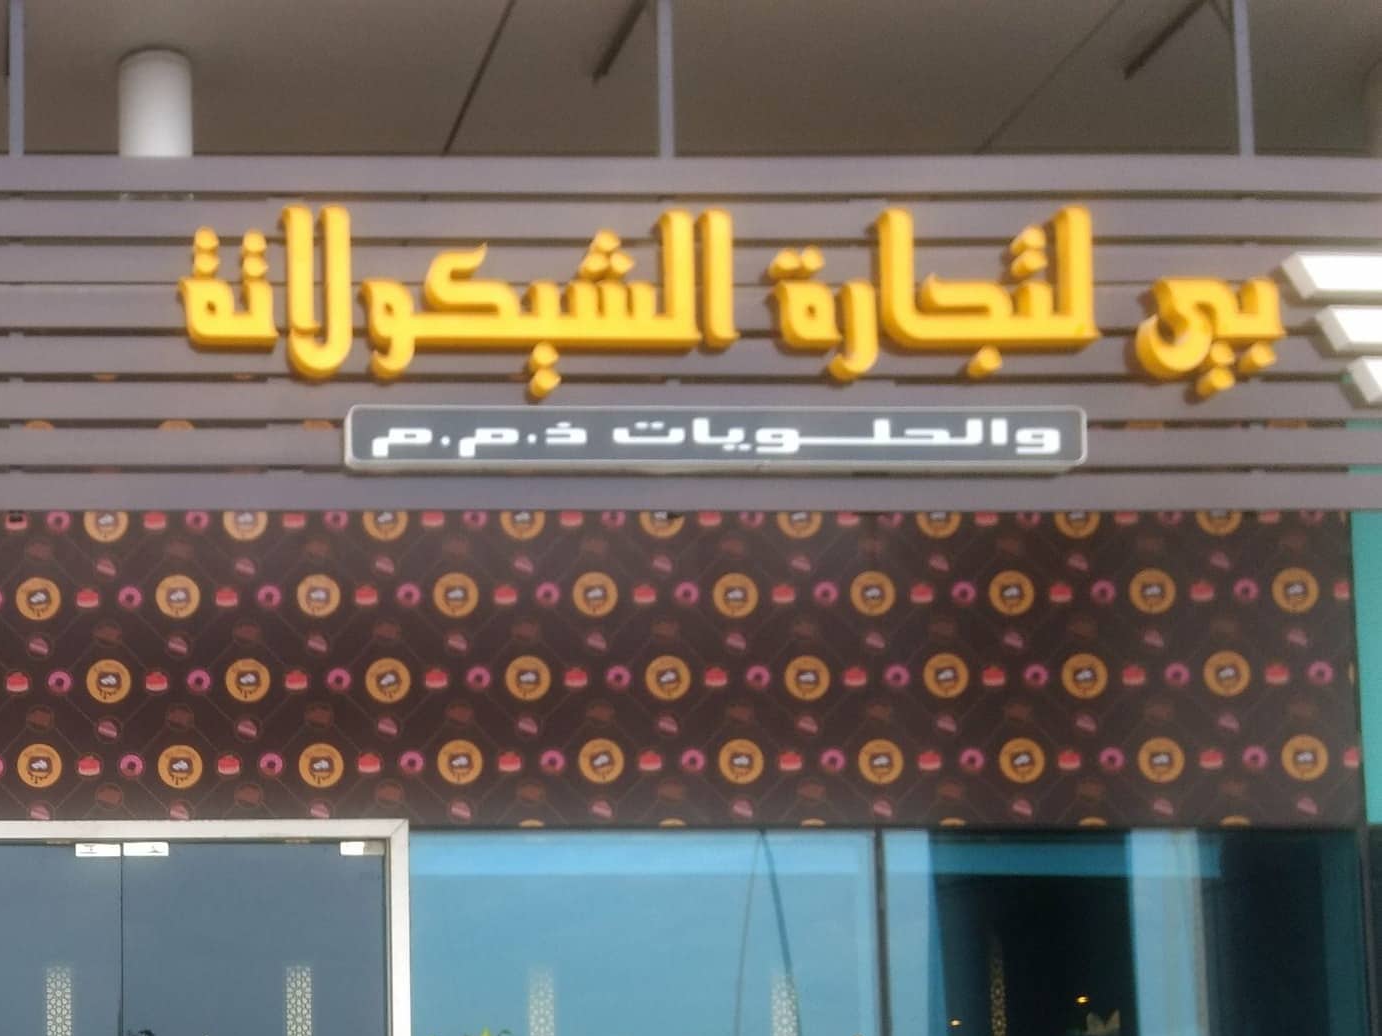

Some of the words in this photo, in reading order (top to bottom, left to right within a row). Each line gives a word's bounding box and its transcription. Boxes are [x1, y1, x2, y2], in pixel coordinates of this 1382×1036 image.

[178, 203, 742, 400] الشيكولاتة
[768, 204, 1101, 382] لتجارة
[1135, 276, 1286, 396] بي
[612, 417, 1060, 455] والحلويات
